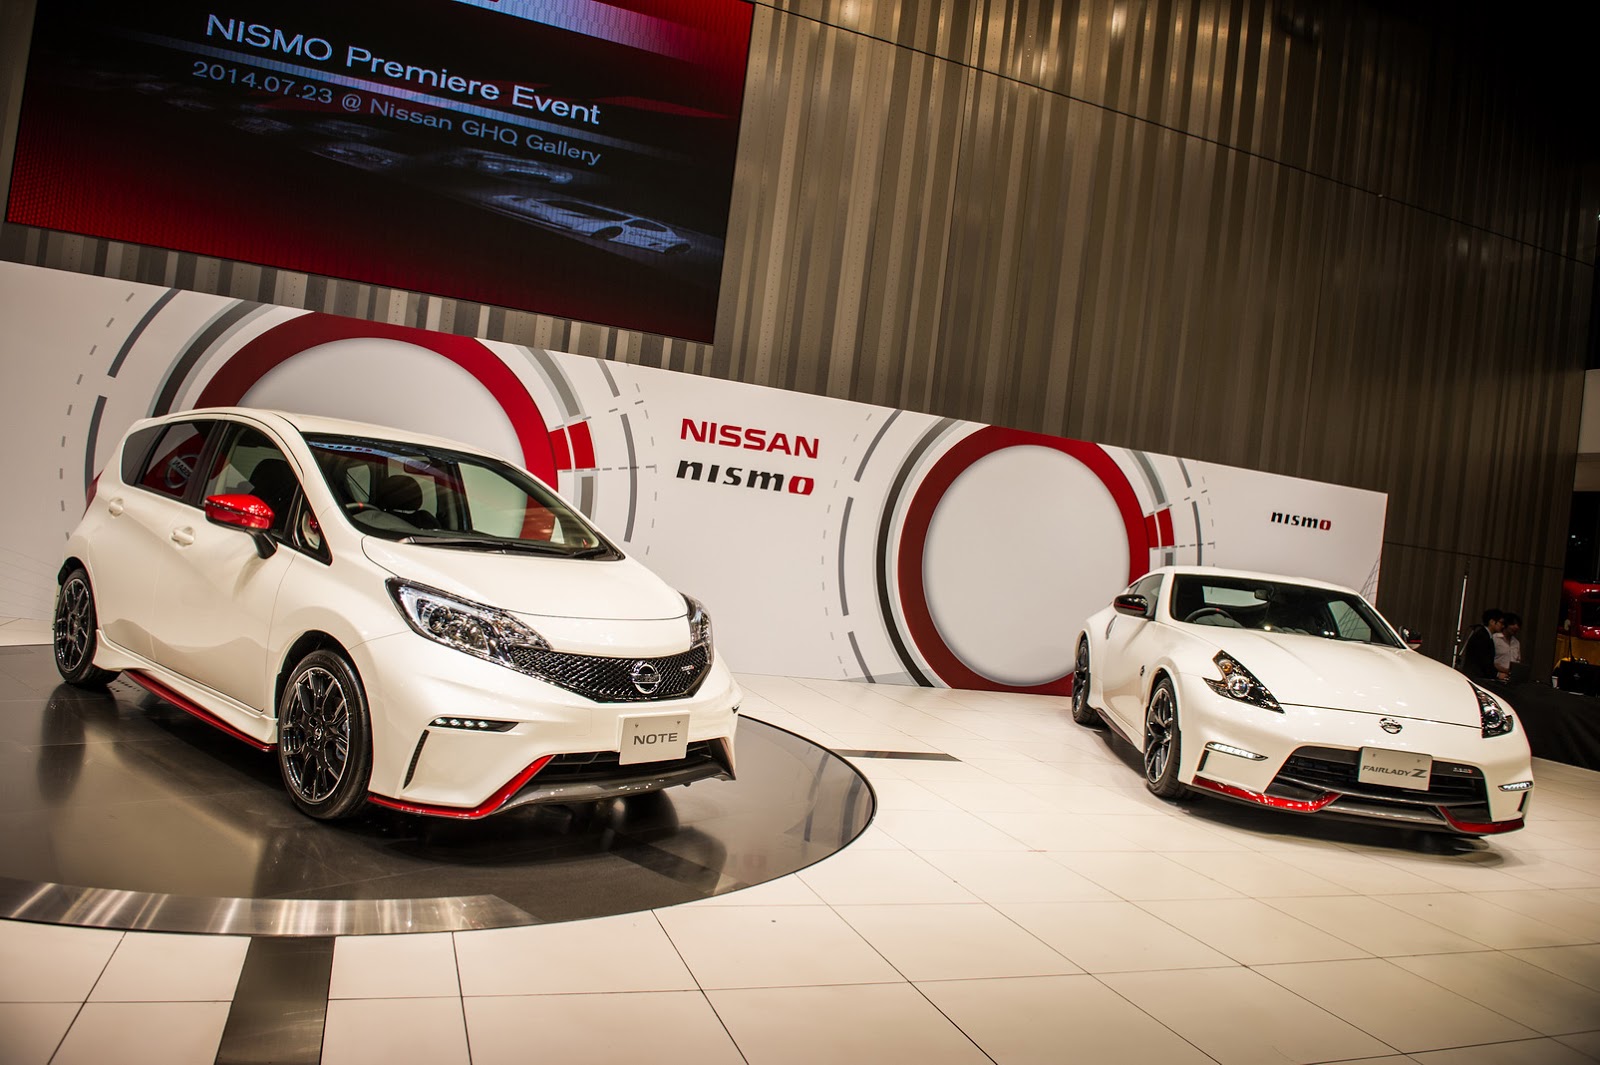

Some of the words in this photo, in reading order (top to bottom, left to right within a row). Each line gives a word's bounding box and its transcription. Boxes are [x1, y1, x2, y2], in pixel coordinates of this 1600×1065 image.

[206, 14, 333, 61] NISMO
[346, 45, 500, 100] Premiere
[512, 85, 601, 125] Event
[193, 61, 333, 104] 2014.07.23
[341, 93, 362, 112] @
[370, 99, 452, 130] Nissan
[461, 119, 518, 147] GHQ
[525, 134, 602, 166] Gallery
[680, 418, 820, 459] NISSAN
[676, 460, 815, 496] nismo
[1270, 511, 1332, 531] nismo
[633, 732, 678, 745] NOTE
[1362, 765, 1412, 777] FAIRLADY
[1411, 768, 1428, 779] Z
